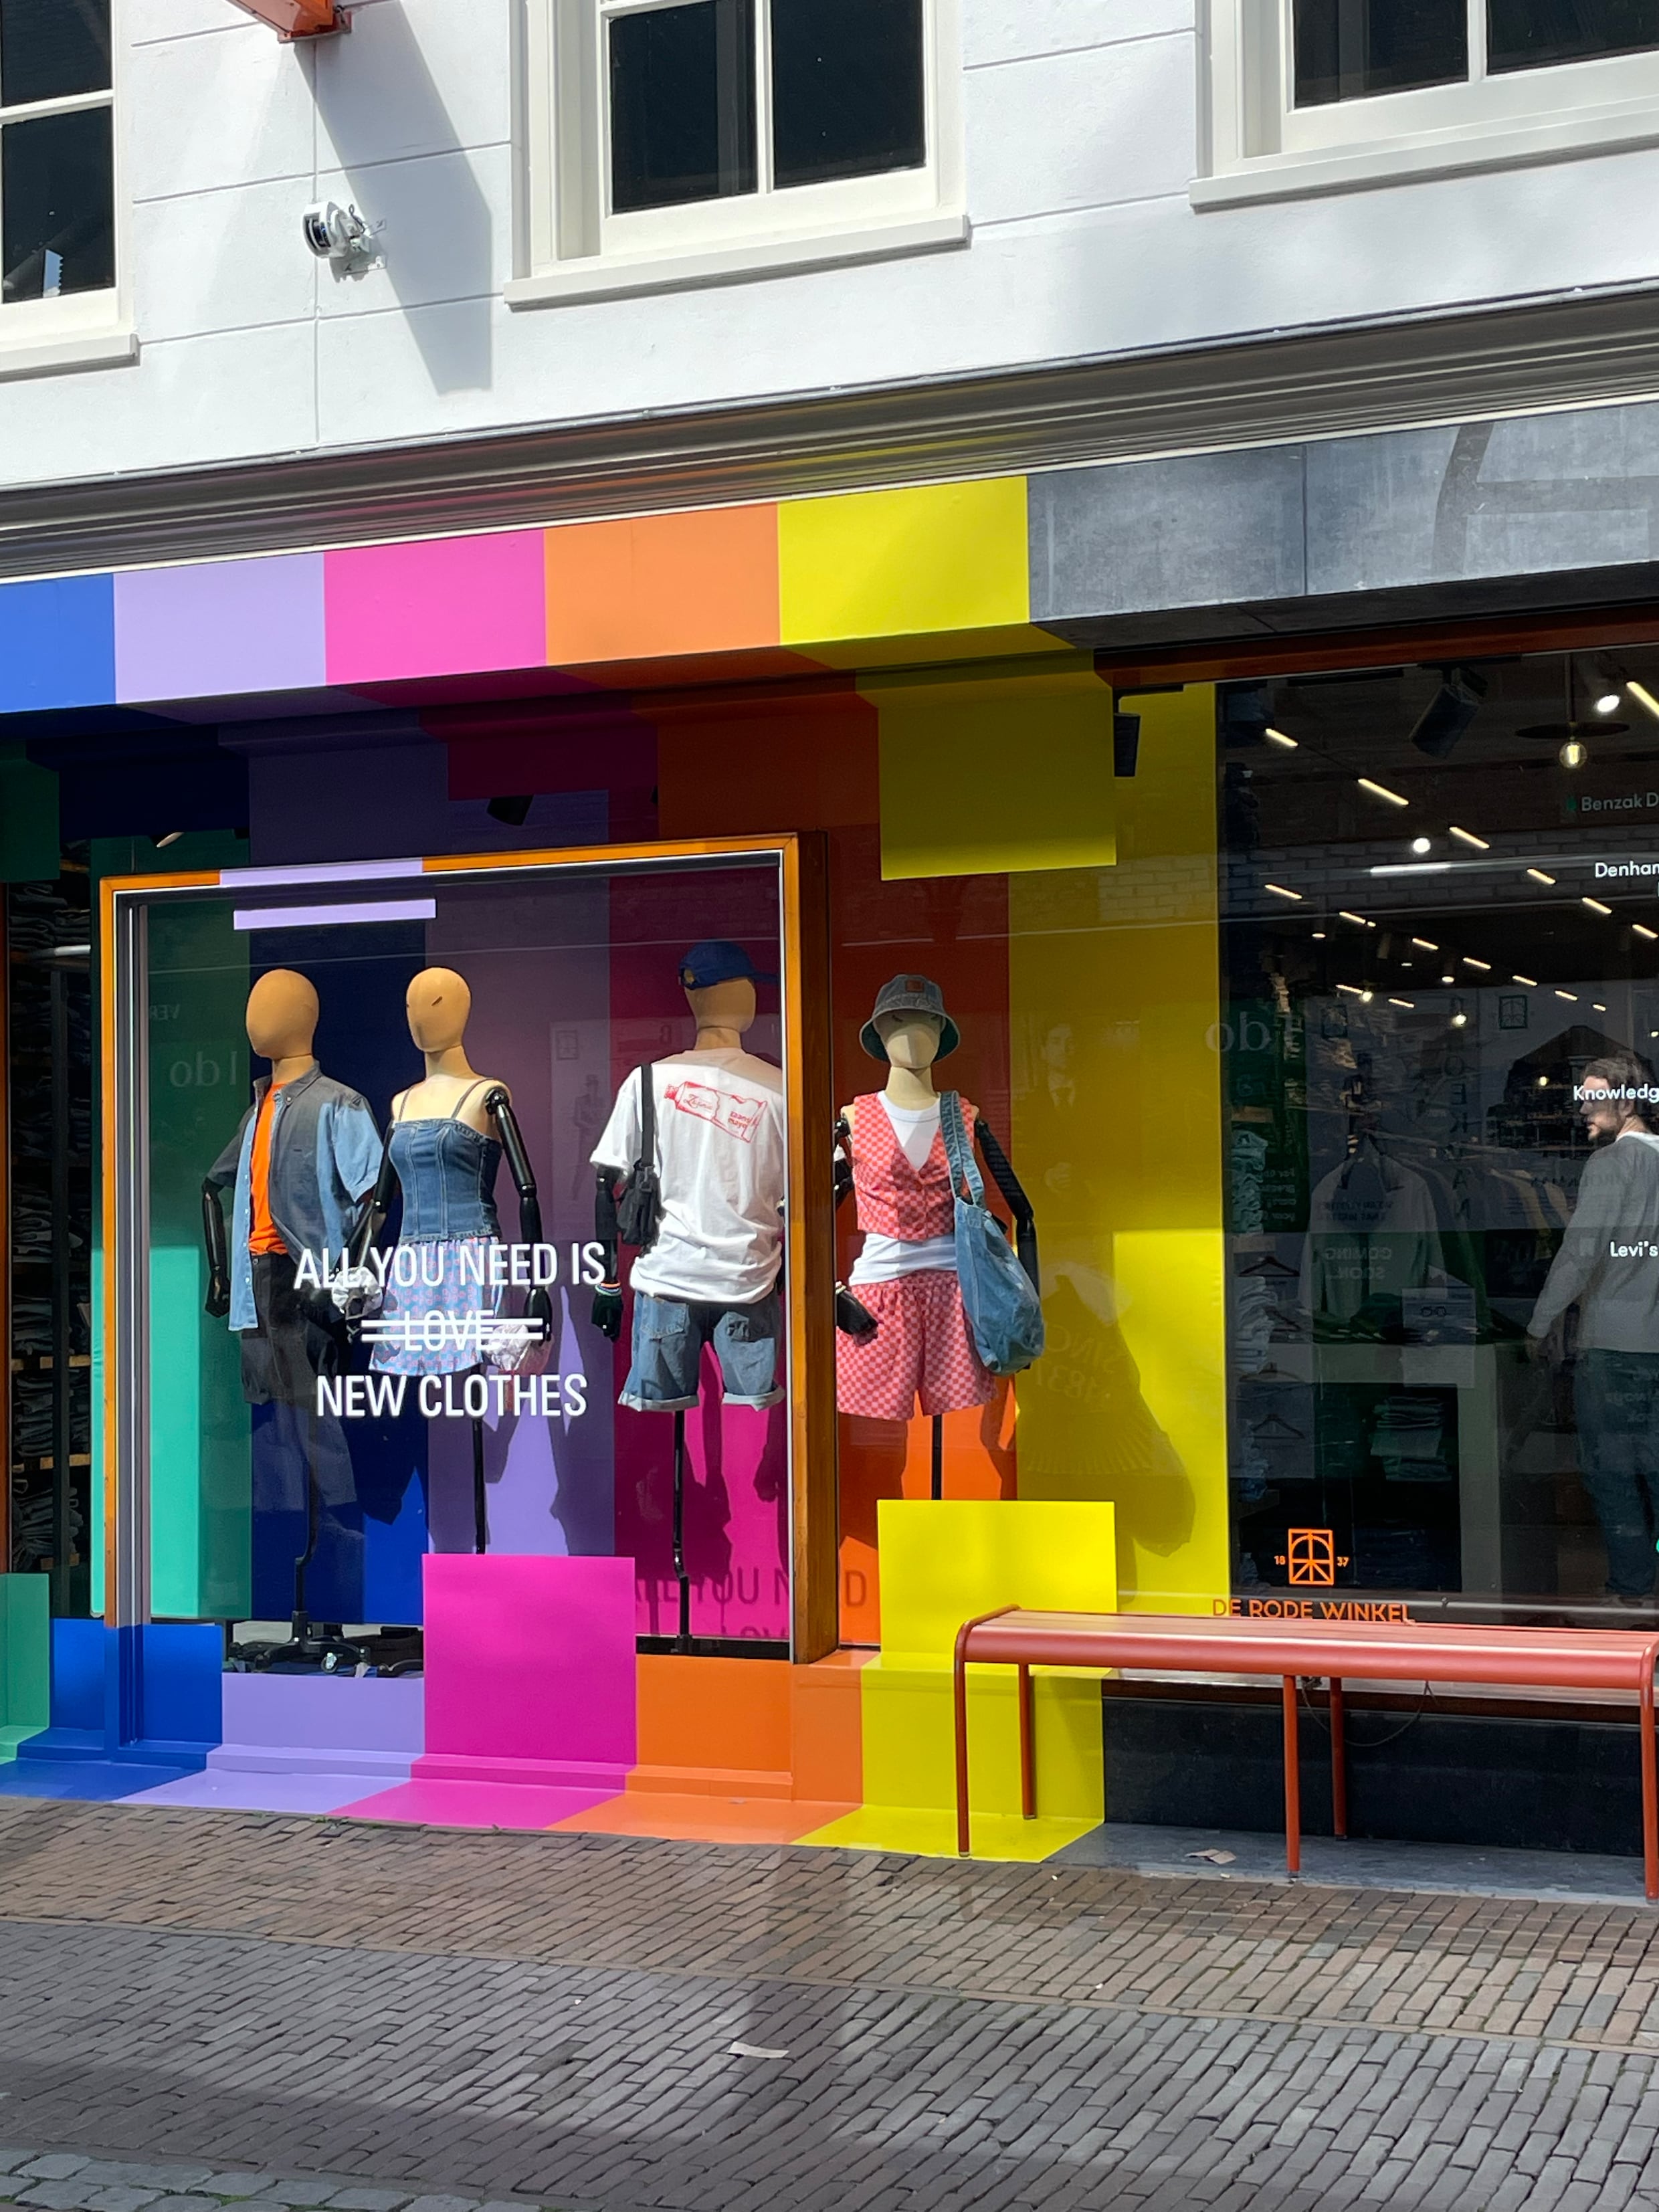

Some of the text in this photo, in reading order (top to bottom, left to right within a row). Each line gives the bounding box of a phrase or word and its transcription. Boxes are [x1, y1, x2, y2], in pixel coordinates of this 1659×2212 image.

[1581, 794, 1643, 811] Benzak
[1573, 1083, 1659, 1104] Knowledg
[1609, 1241, 1659, 1258] Levi's
[293, 1241, 605, 1290] ALL YOU NEED IS
[404, 1309, 498, 1352] LOVE
[316, 1373, 588, 1417] NEW CLOTHES
[1212, 1598, 1413, 1623] DE RODE WINKEL
